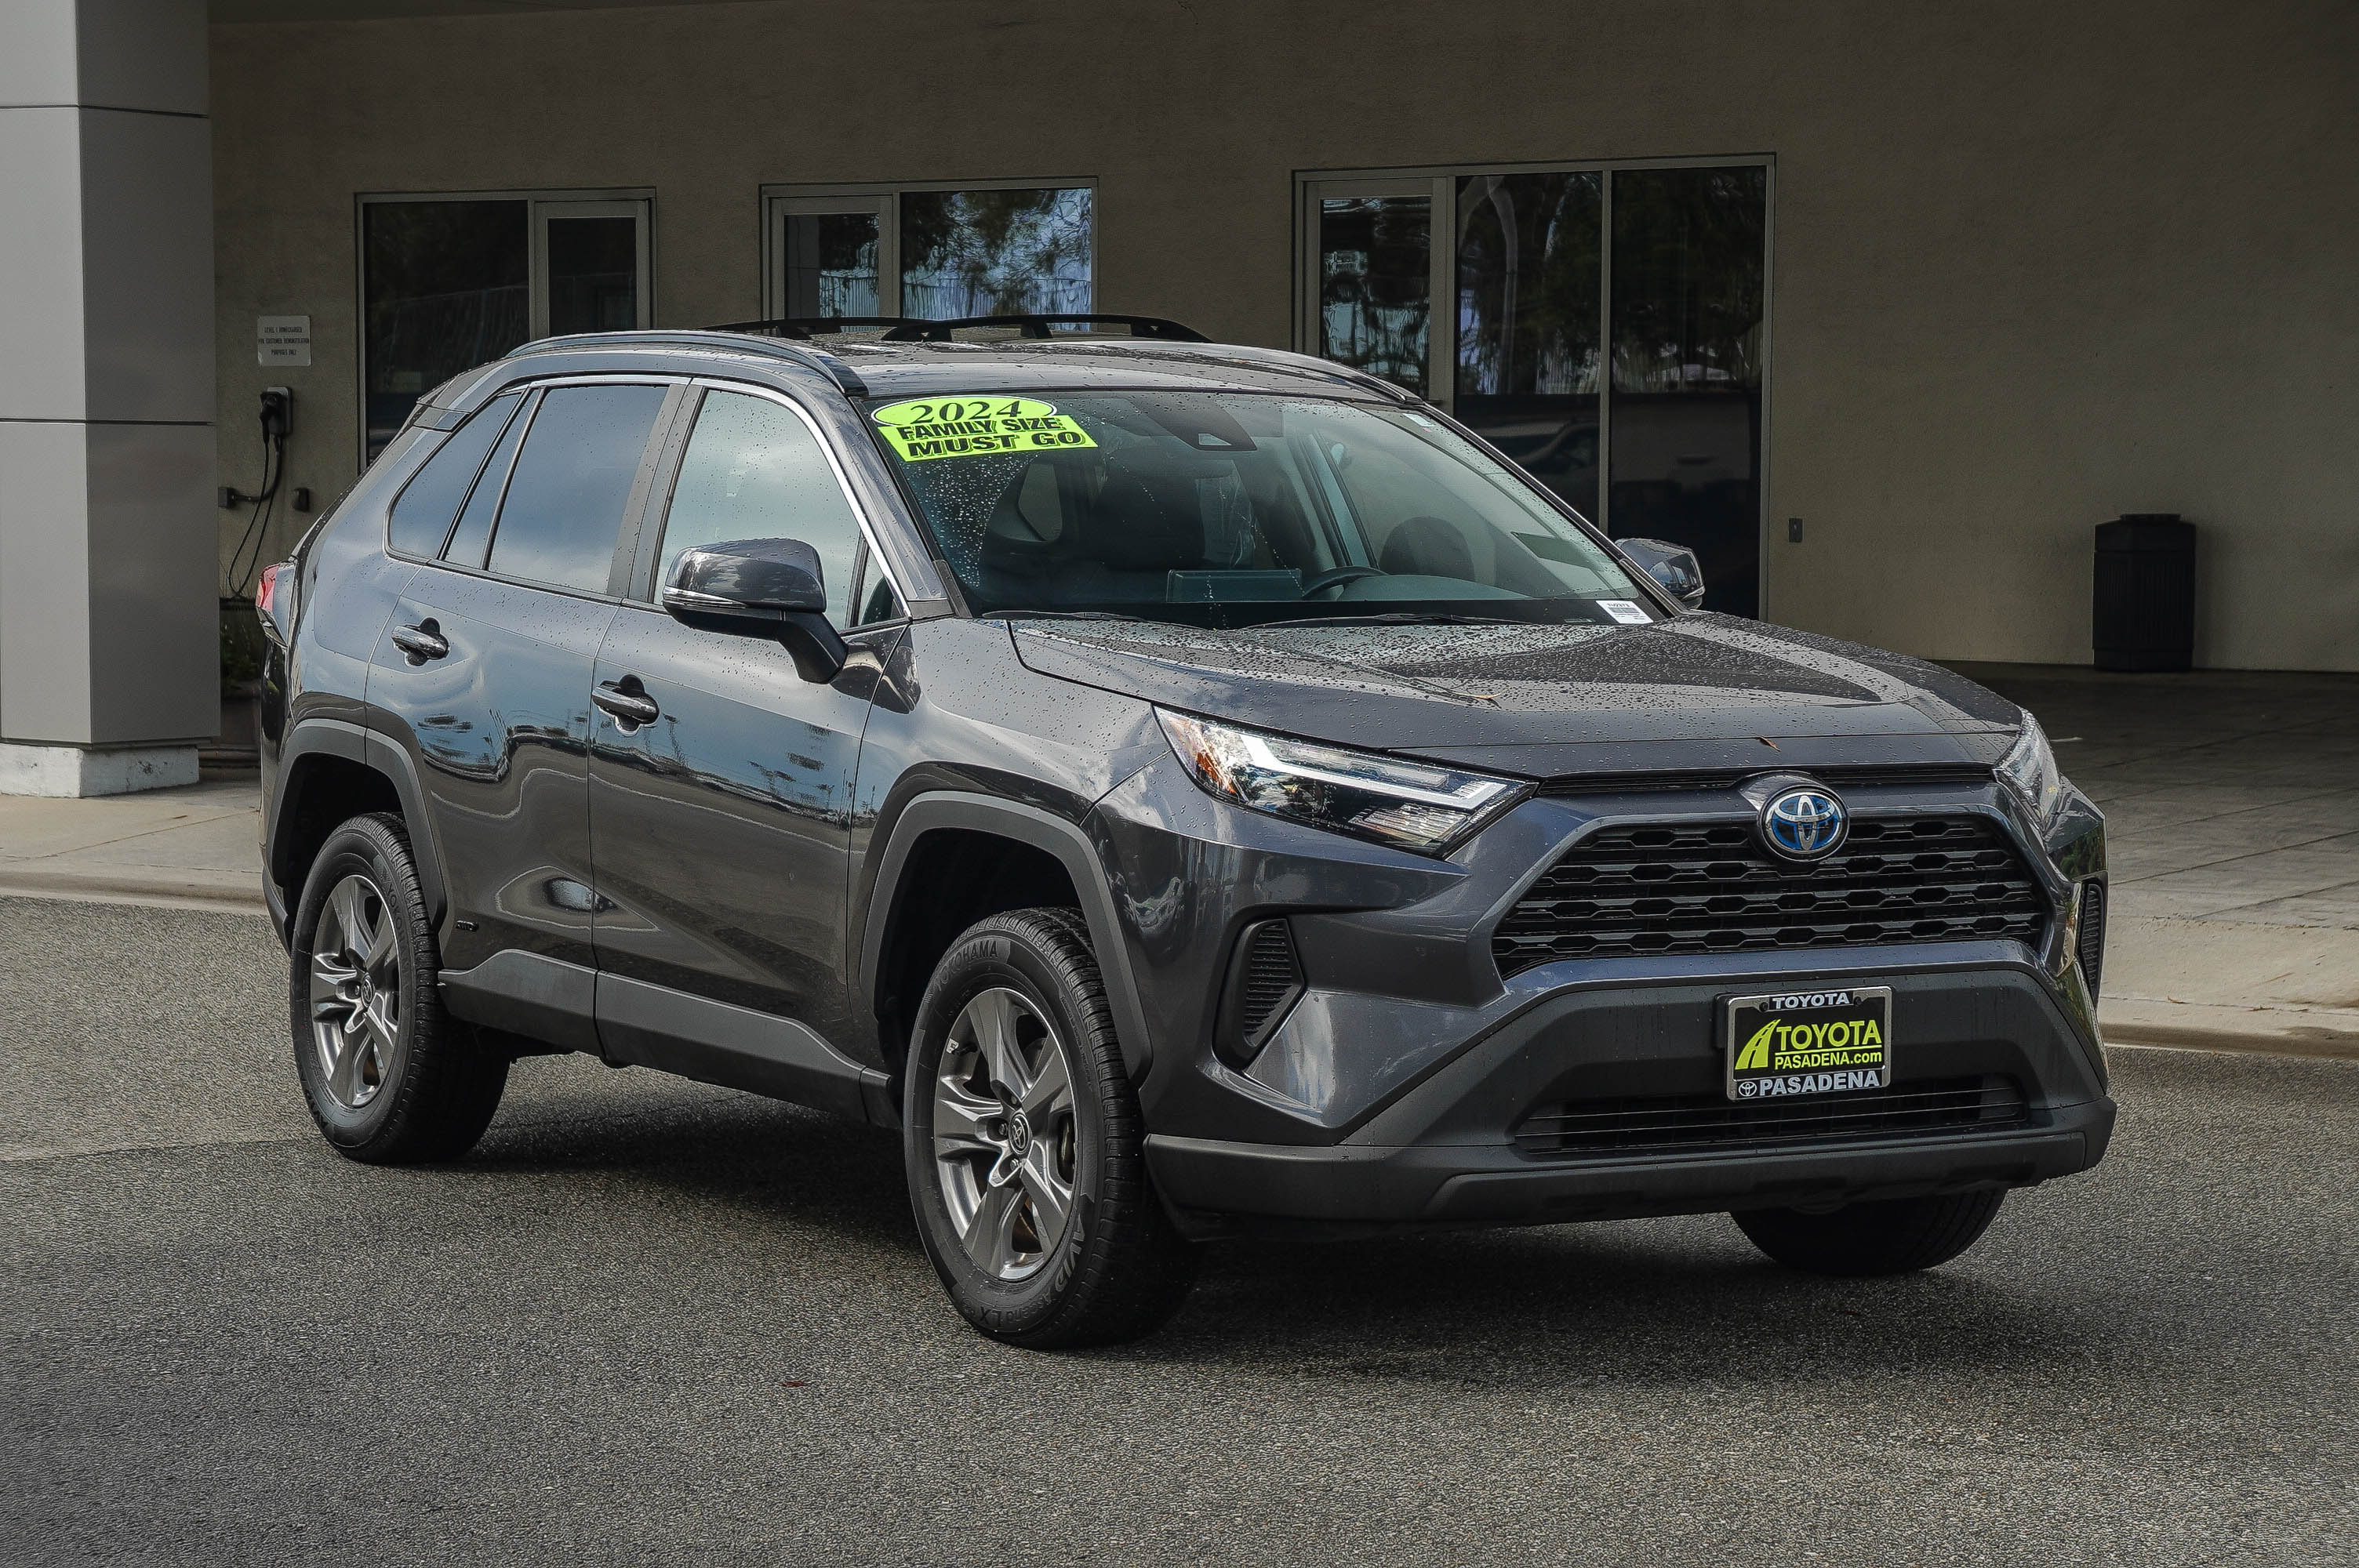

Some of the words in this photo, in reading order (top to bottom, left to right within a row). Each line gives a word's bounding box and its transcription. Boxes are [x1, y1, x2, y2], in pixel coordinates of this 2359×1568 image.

[910, 400, 1022, 425] 2024
[896, 419, 996, 441] FAMILY
[1002, 416, 1067, 432] SIZE
[907, 434, 1019, 457] MUST
[1031, 431, 1085, 447] GO
[1772, 993, 1850, 1010] TOYOTA
[1776, 1019, 1882, 1051] TOYOTA
[1775, 1051, 1882, 1070] PASADENA.com
[1759, 1070, 1880, 1096] PASADENA
